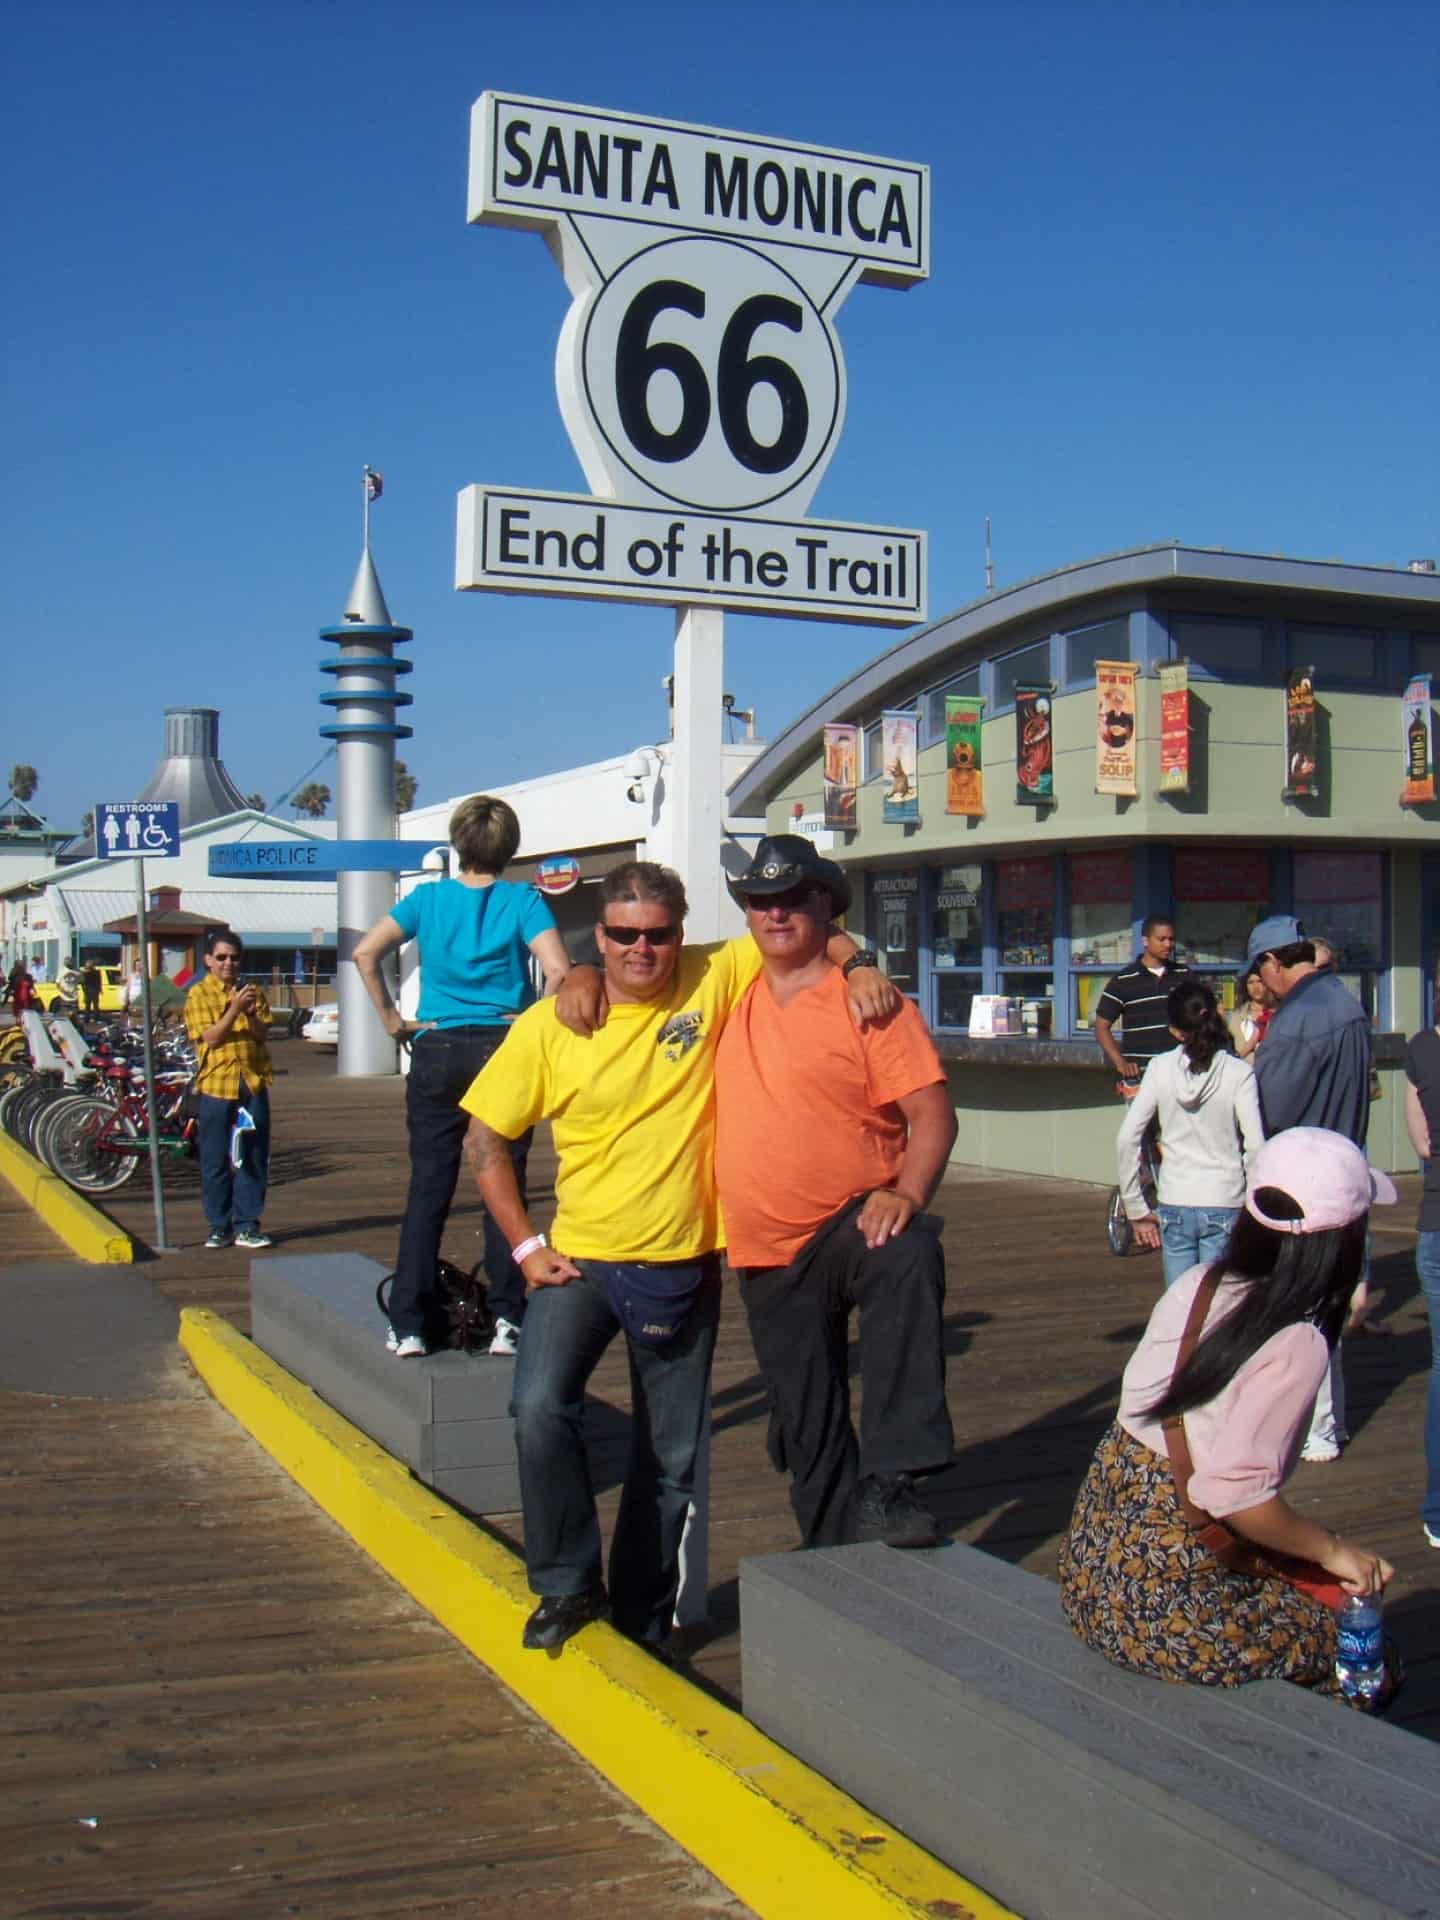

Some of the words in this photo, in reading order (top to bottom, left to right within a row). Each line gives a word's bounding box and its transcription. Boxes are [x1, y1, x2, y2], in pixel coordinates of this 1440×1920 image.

[504, 119, 681, 211] SANTA
[704, 151, 913, 249] MONICA
[615, 279, 809, 475] 66
[499, 508, 605, 571] End
[627, 522, 685, 577] of
[701, 527, 788, 588] the
[795, 537, 907, 599] Trail
[105, 803, 168, 813] RESTROOMS
[256, 847, 318, 865] POLICE
